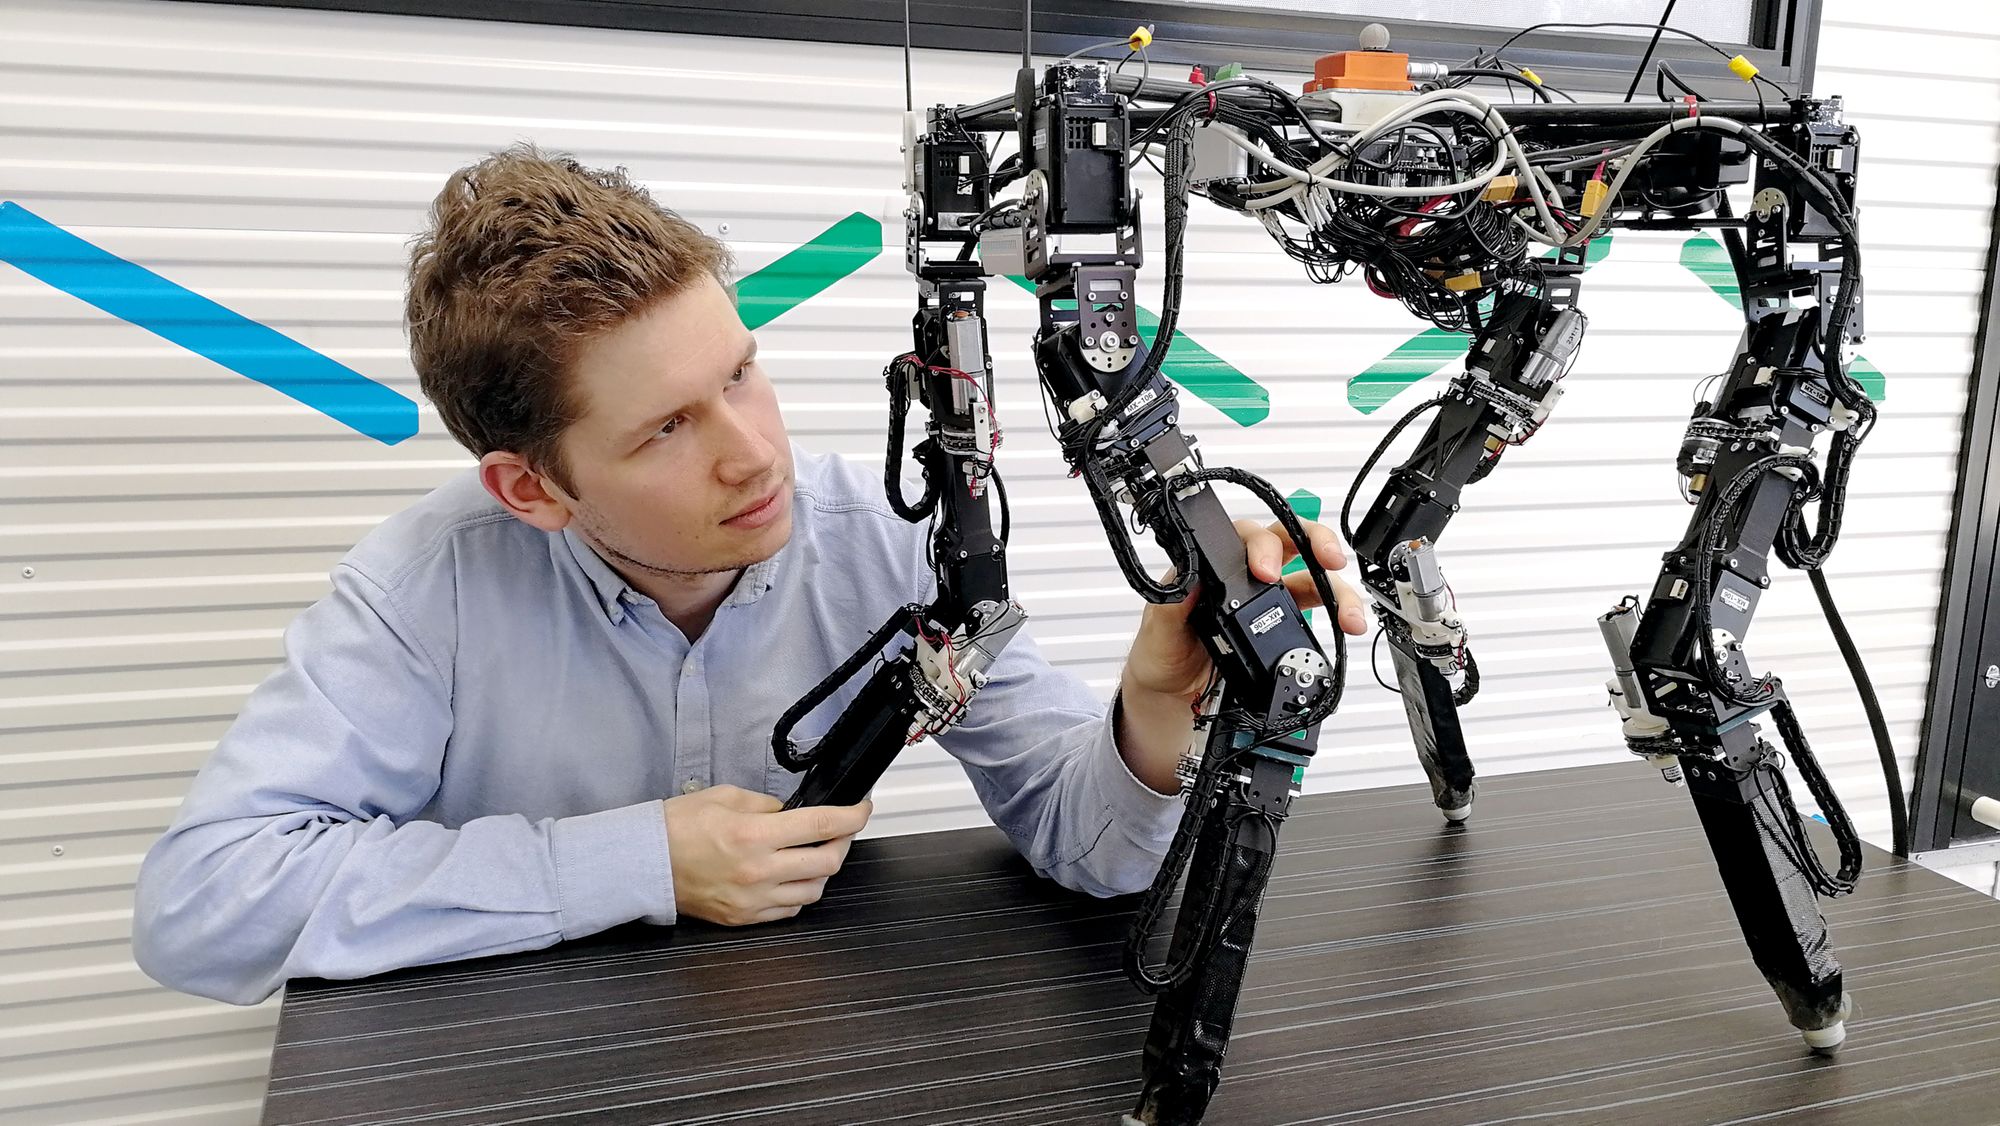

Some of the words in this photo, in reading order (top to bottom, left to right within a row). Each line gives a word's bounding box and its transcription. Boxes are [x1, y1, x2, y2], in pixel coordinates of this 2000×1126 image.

[1804, 384, 1826, 401] MX-106
[1126, 392, 1154, 412] MX-106
[1724, 591, 1746, 606] MX-106
[1253, 610, 1281, 631] MX-106
